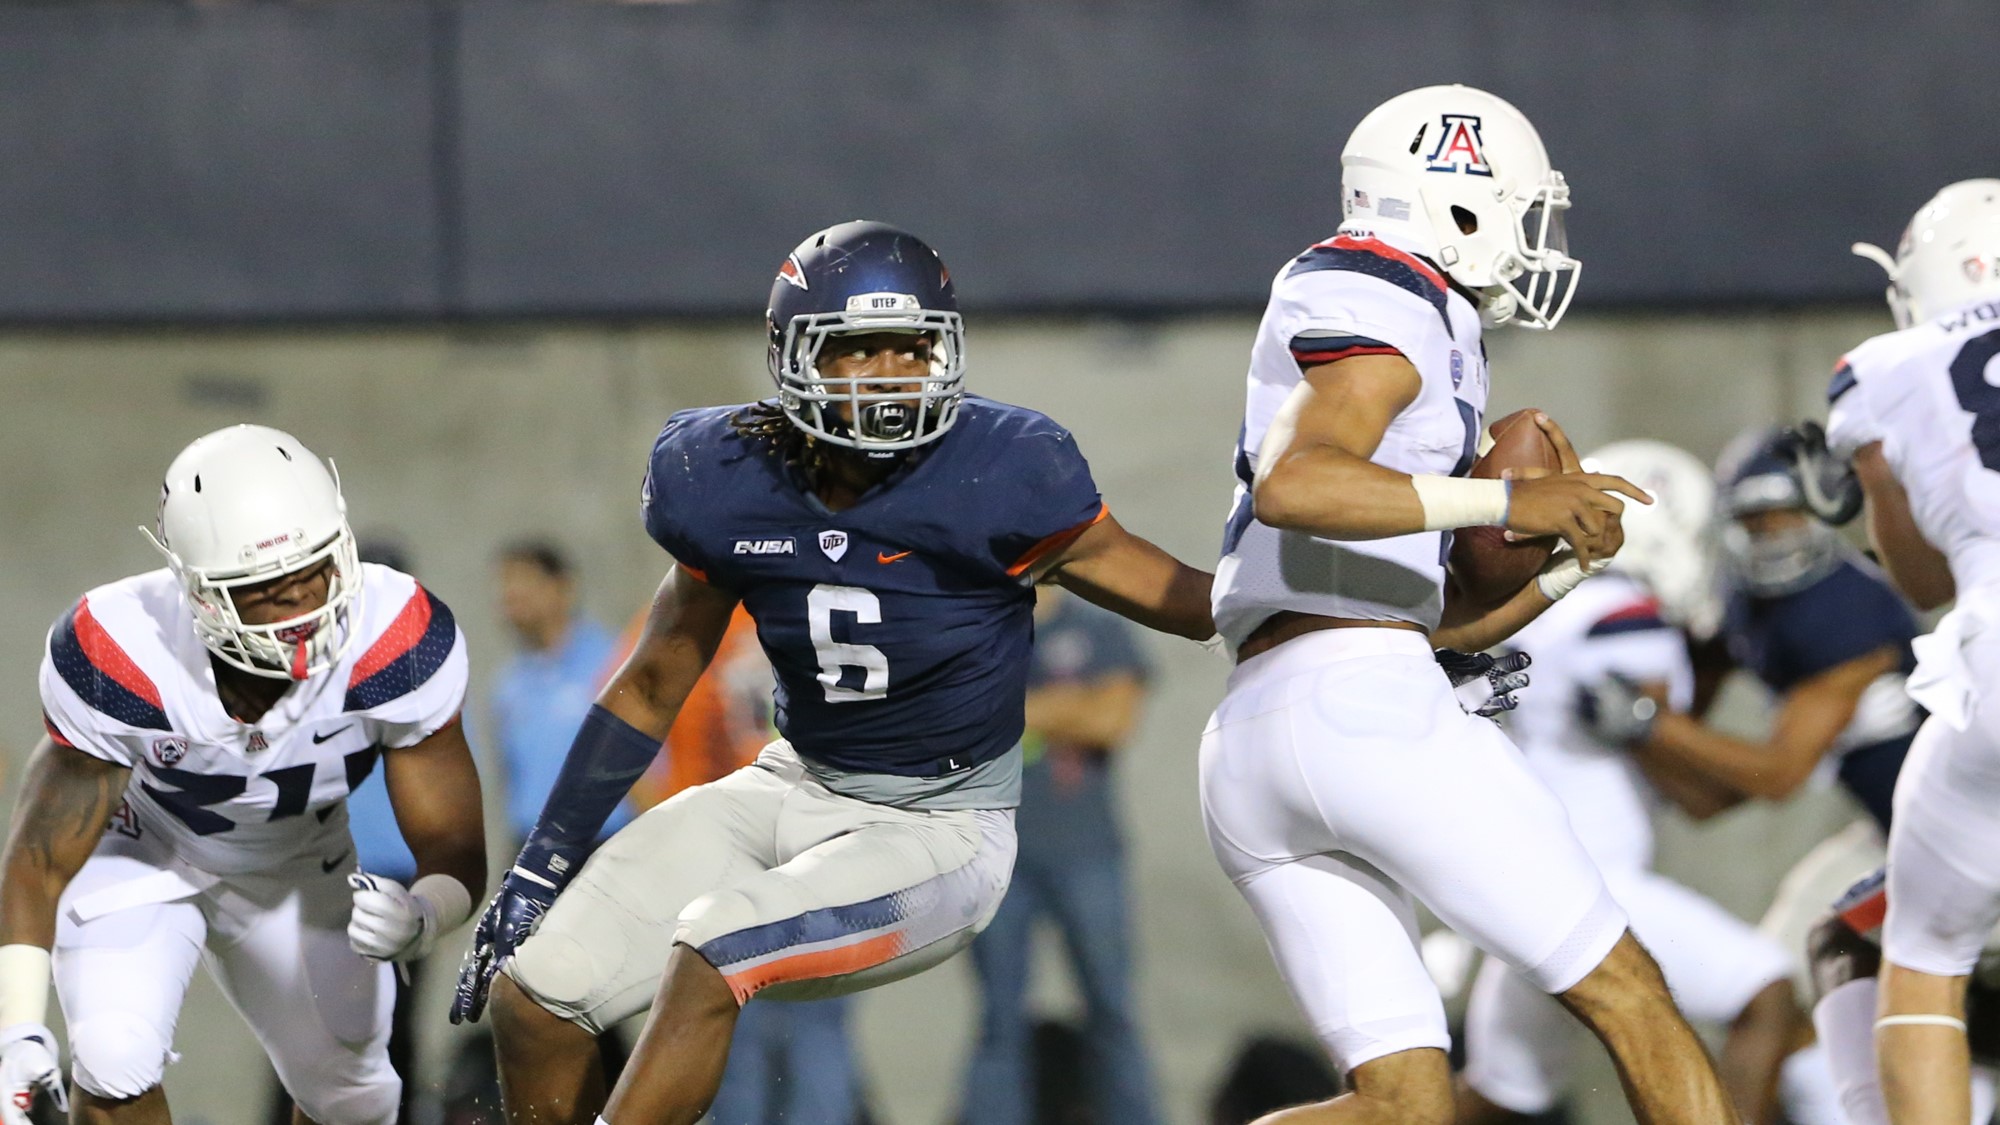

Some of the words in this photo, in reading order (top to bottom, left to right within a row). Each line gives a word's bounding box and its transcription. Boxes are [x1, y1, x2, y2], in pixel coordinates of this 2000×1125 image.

[1426, 114, 1493, 177] A
[872, 298, 896, 308] UTEP
[822, 534, 846, 551] UTEP
[807, 583, 889, 704] 6
[949, 758, 960, 770] L
